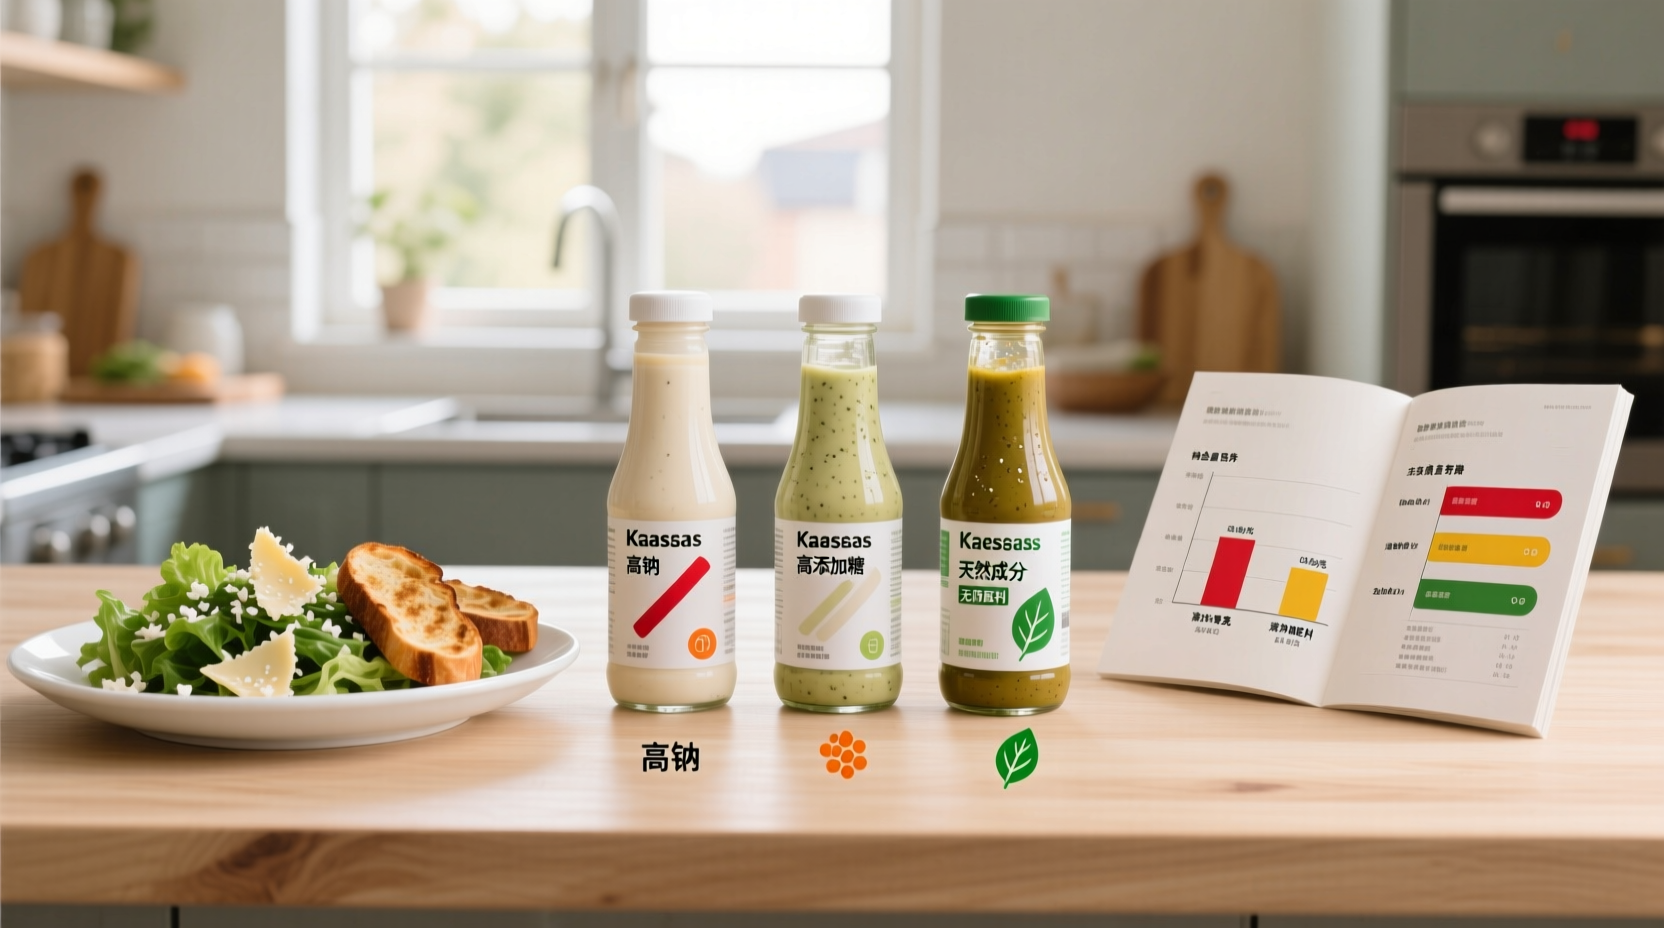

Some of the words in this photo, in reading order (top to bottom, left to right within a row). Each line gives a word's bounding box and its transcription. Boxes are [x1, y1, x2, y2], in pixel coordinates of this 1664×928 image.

[626, 555, 660, 576] 高钠
[796, 554, 865, 575] 高添加糖
[958, 560, 1028, 581] 天然成分
